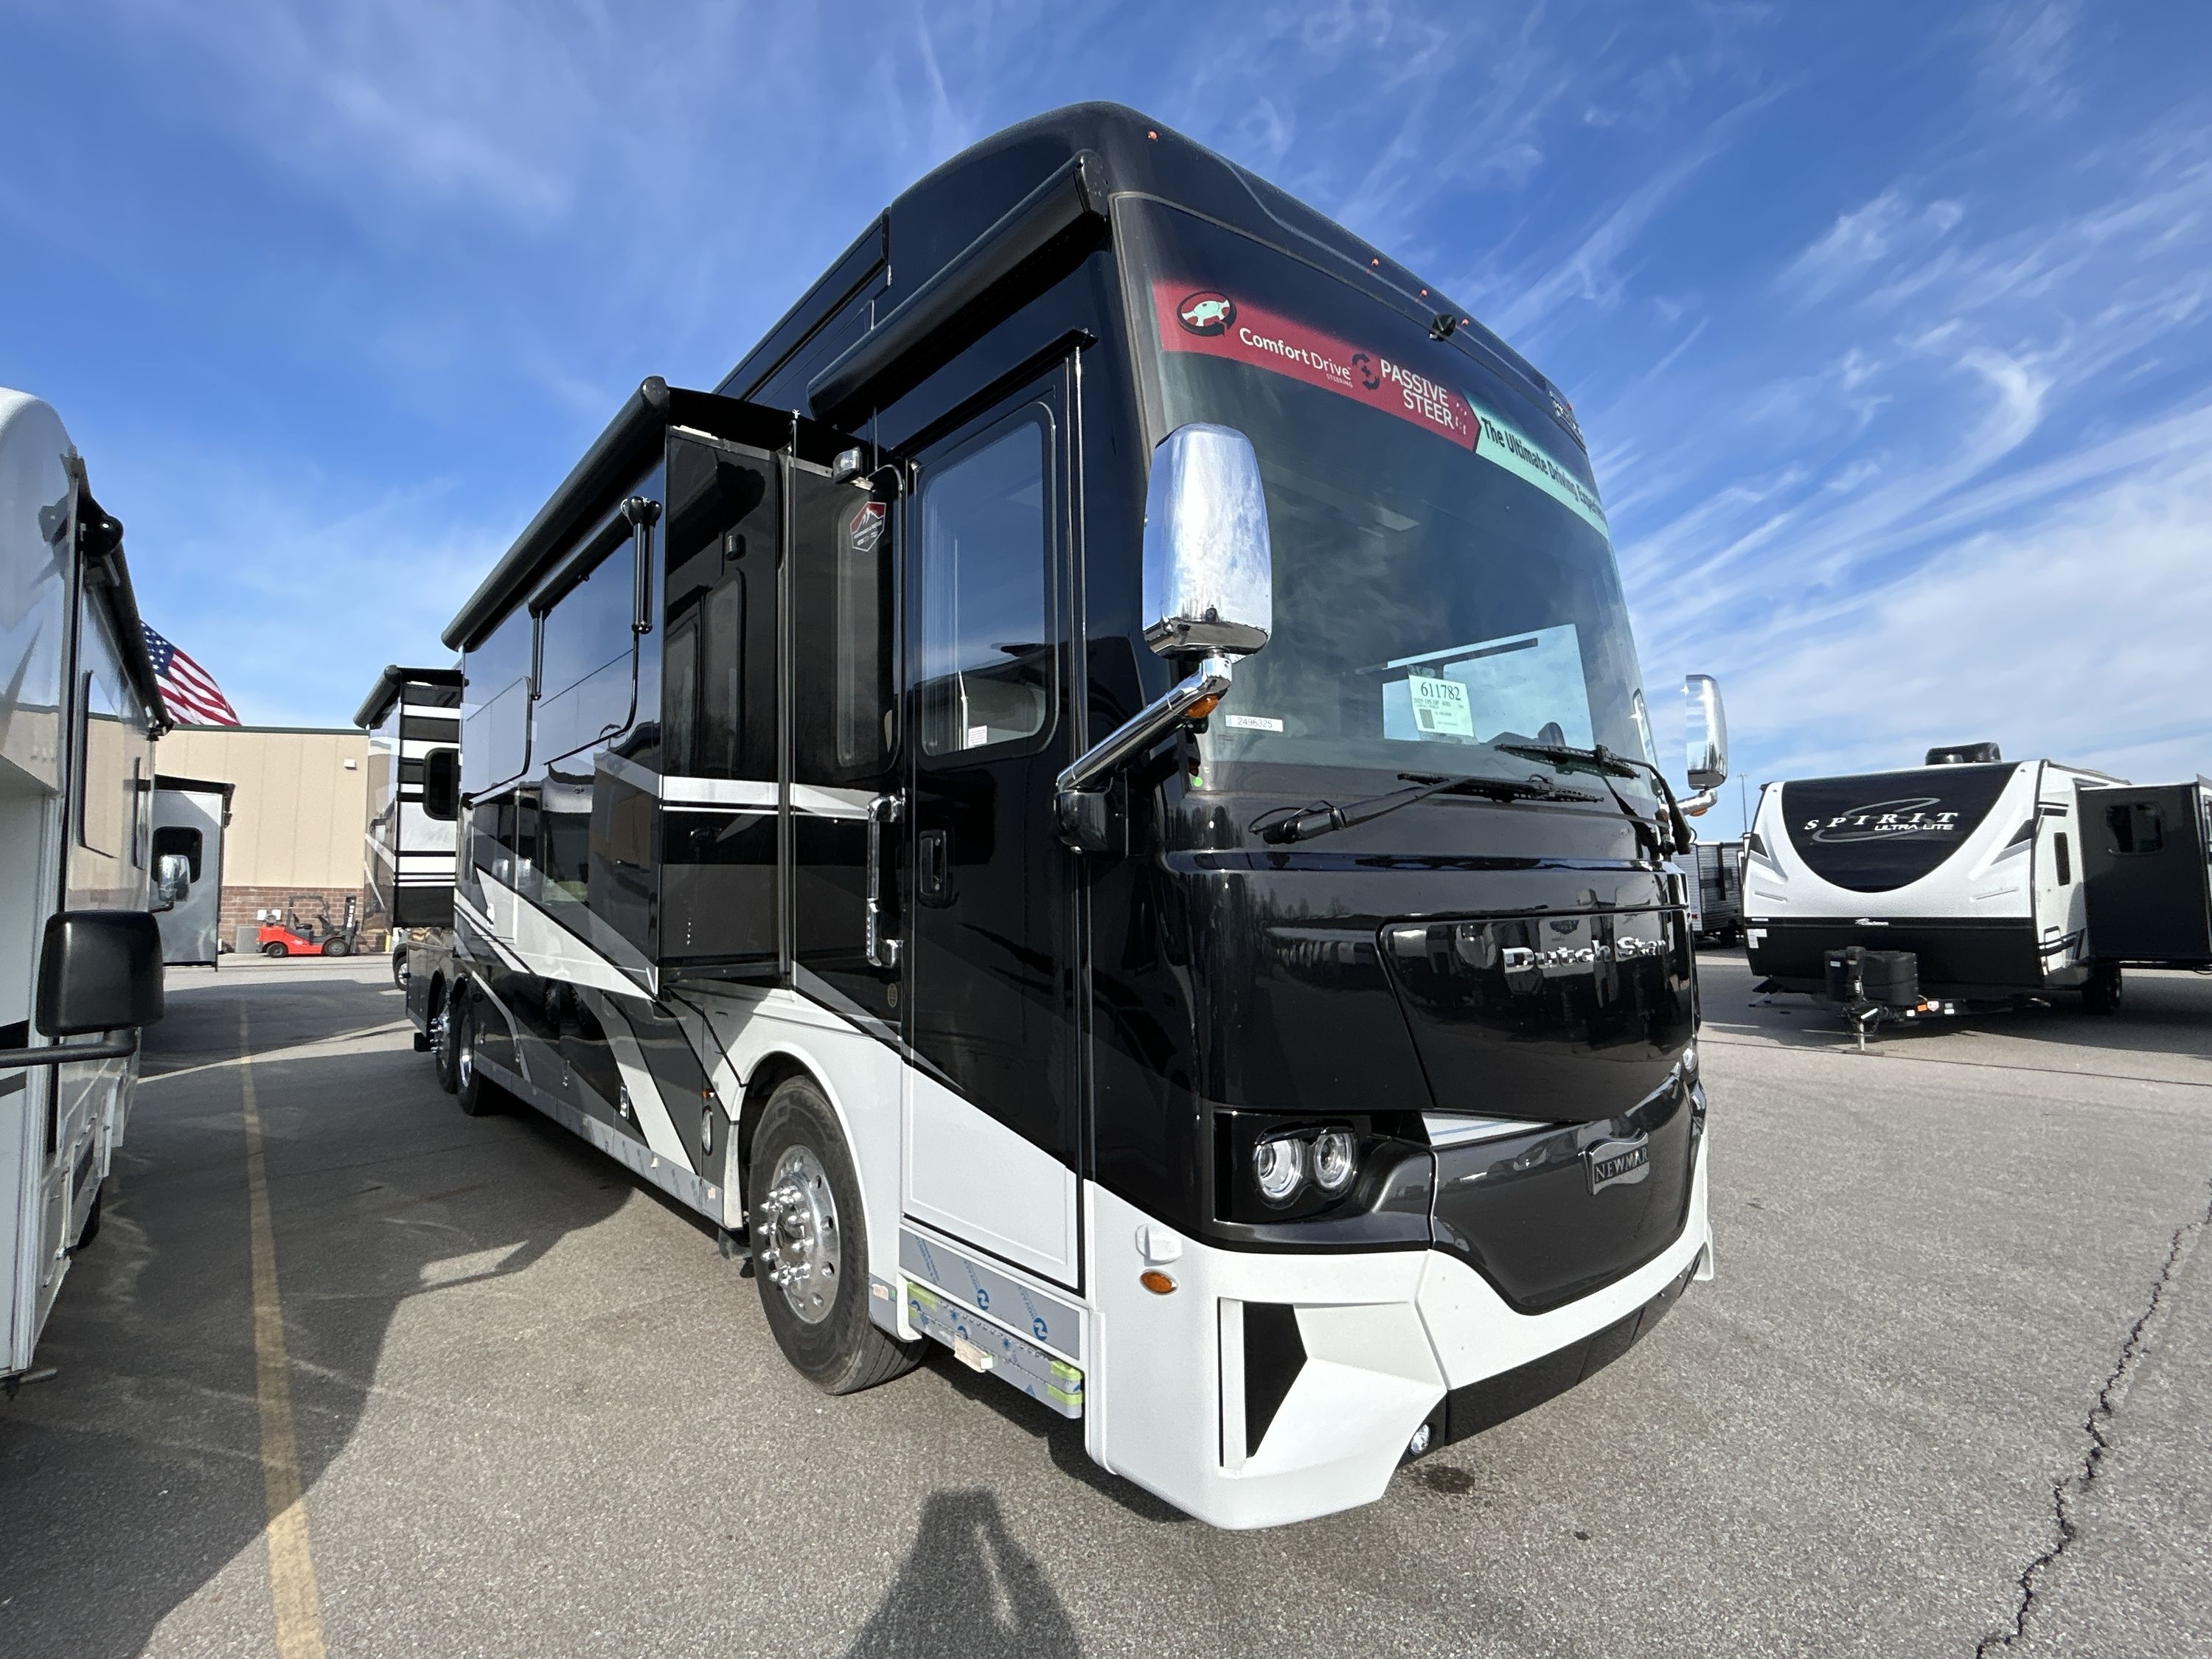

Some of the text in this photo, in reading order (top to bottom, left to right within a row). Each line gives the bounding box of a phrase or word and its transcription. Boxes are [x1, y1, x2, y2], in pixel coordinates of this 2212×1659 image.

[1326, 373, 1354, 389] STEERING
[1380, 358, 1450, 407] PASSIVE
[1402, 389, 1455, 430] STEER
[1481, 417, 1506, 448] The
[1504, 430, 1548, 476] Ultimate
[1420, 681, 1462, 701] 611782
[1237, 717, 1273, 728] 2496325
[1804, 812, 1958, 830] SPIRIT
[1501, 936, 1666, 974] Dutch Star
